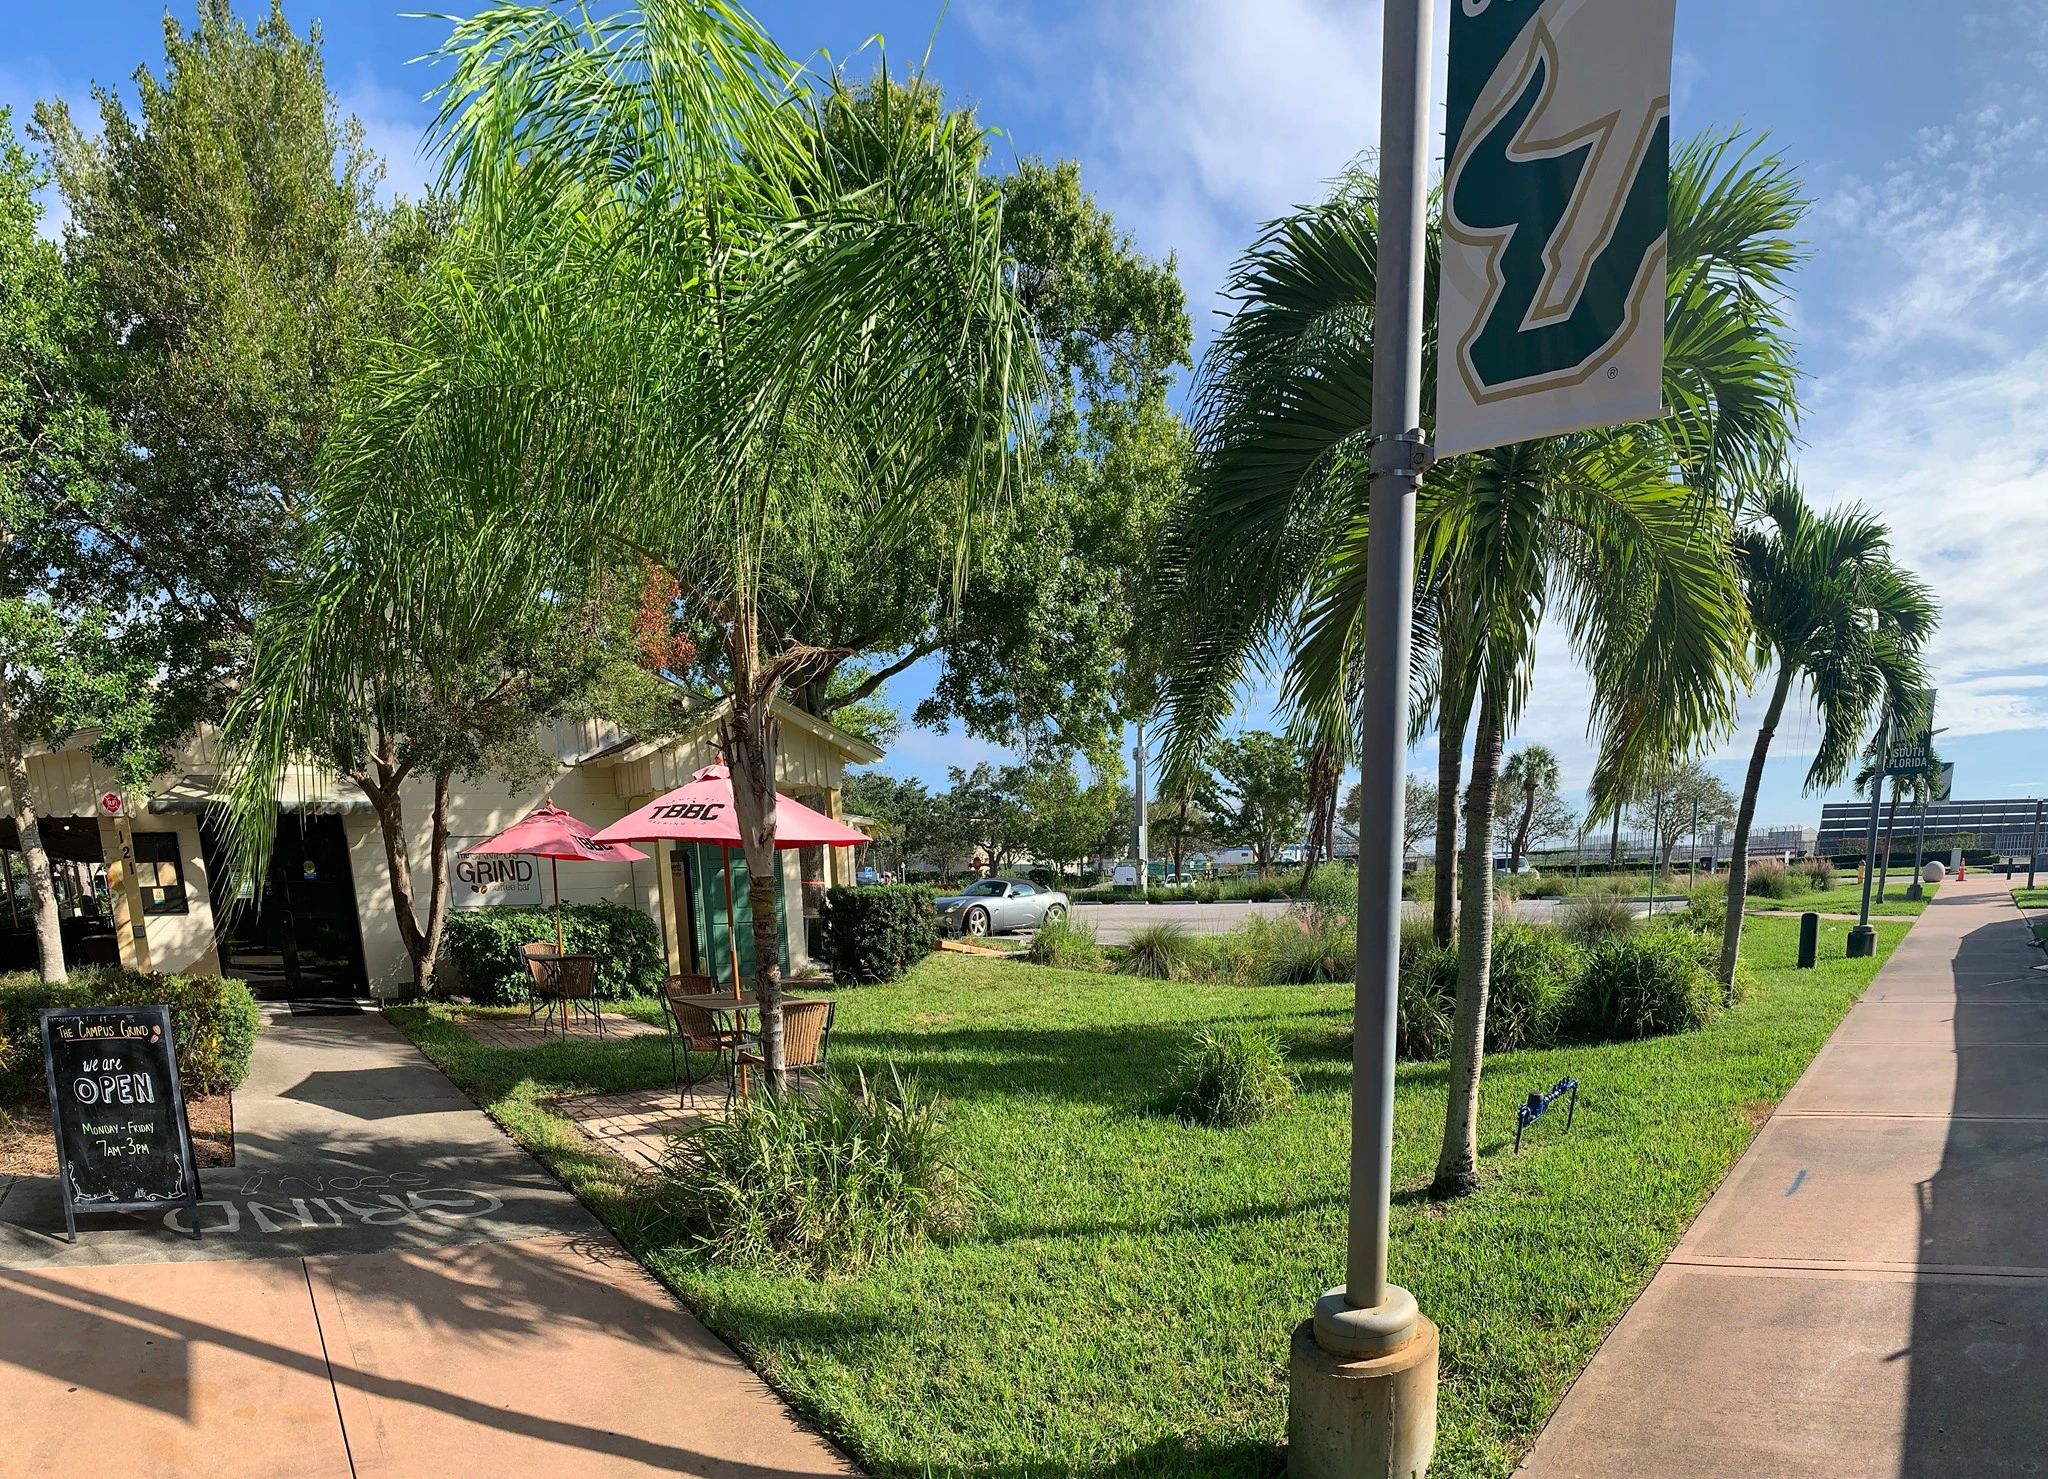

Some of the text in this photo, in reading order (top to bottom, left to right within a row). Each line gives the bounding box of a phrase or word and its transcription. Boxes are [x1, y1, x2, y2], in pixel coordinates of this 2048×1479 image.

[1893, 746, 1925, 758] SOUTH
[1888, 757, 1927, 769] FLORIDA
[648, 803, 725, 821] TBBC
[456, 859, 533, 884] GRIND
[517, 881, 531, 891] bar
[57, 1019, 149, 1039] THE CAMPUS GRIND
[82, 1058, 123, 1073] we are
[73, 1072, 156, 1105] OPEN
[81, 1122, 118, 1136] MONDAY
[127, 1121, 154, 1134] FRIDAY
